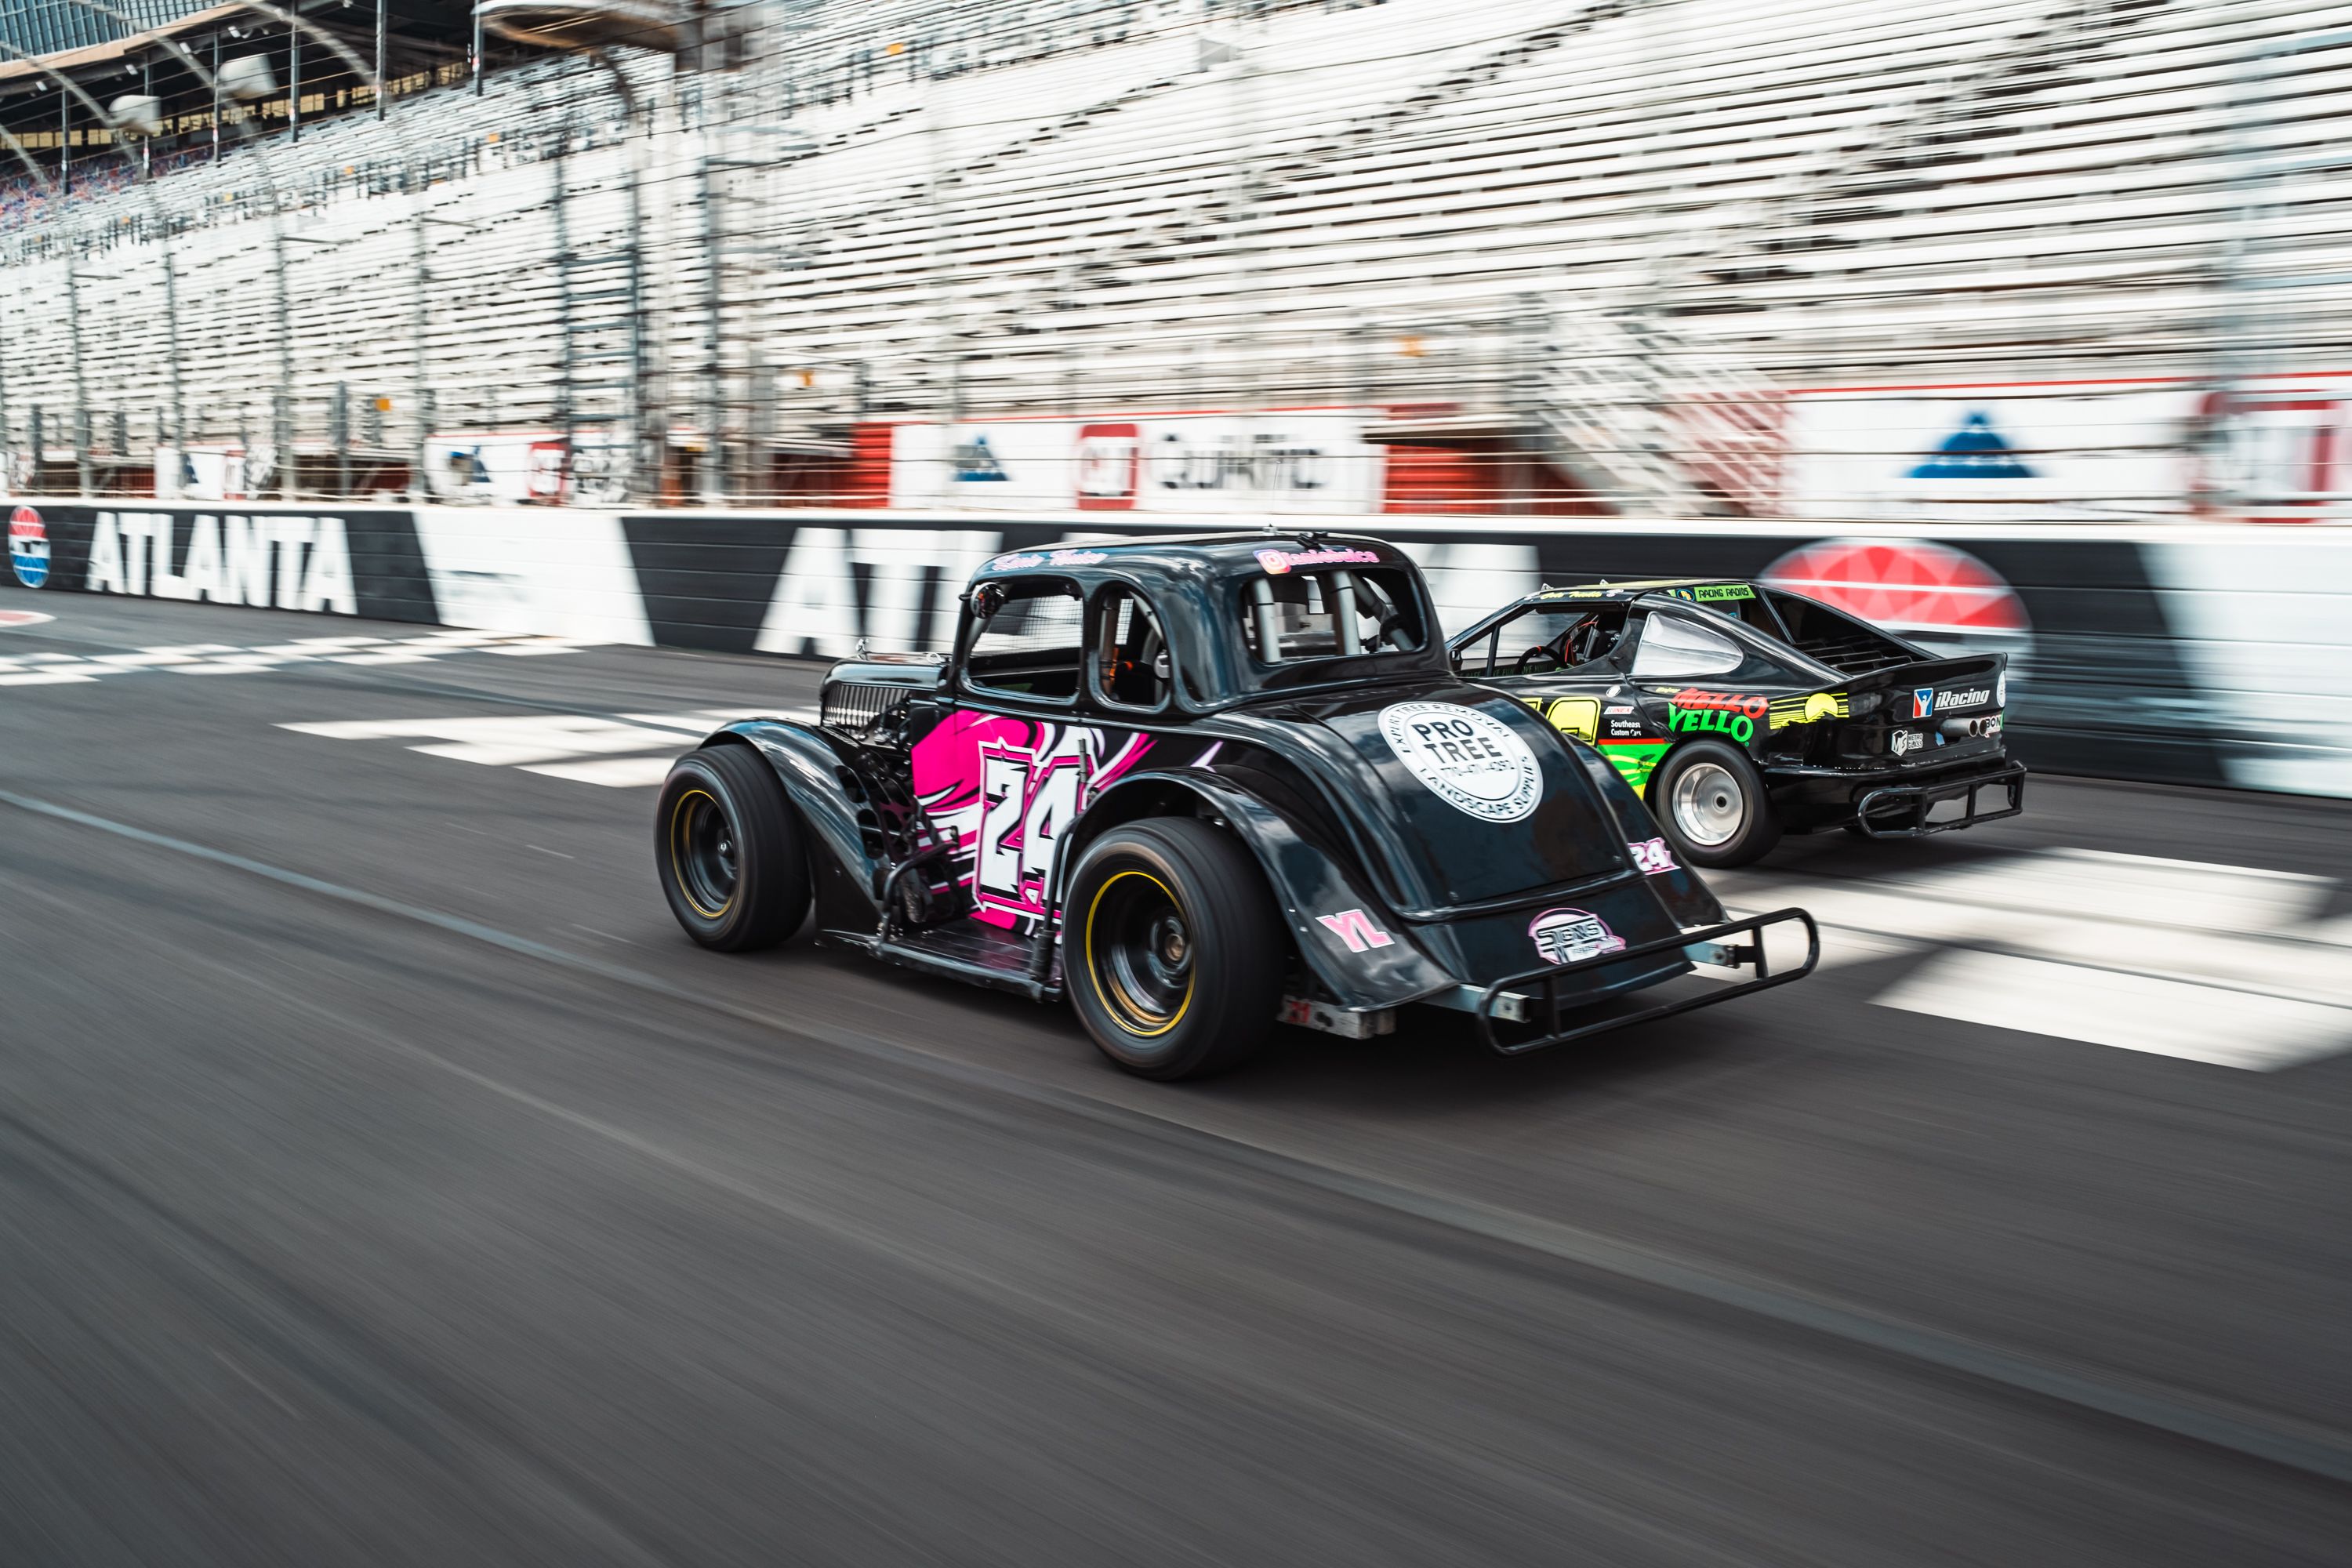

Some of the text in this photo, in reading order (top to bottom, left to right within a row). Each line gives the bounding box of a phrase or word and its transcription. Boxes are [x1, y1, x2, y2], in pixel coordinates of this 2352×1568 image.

[85, 512, 358, 615] ATLANTA
[1698, 589, 1724, 599] RACING
[1726, 587, 1750, 597] RADIOS
[1670, 687, 1768, 719] MELLO
[1934, 688, 1991, 710] iRacing
[1411, 719, 1474, 742] PRO
[1610, 720, 1641, 728] Southeast
[1668, 702, 1754, 742] YELLO
[1423, 736, 1503, 764] TREE
[977, 745, 1091, 909] 24
[1628, 838, 1676, 875] 24
[1316, 909, 1396, 953] YL
